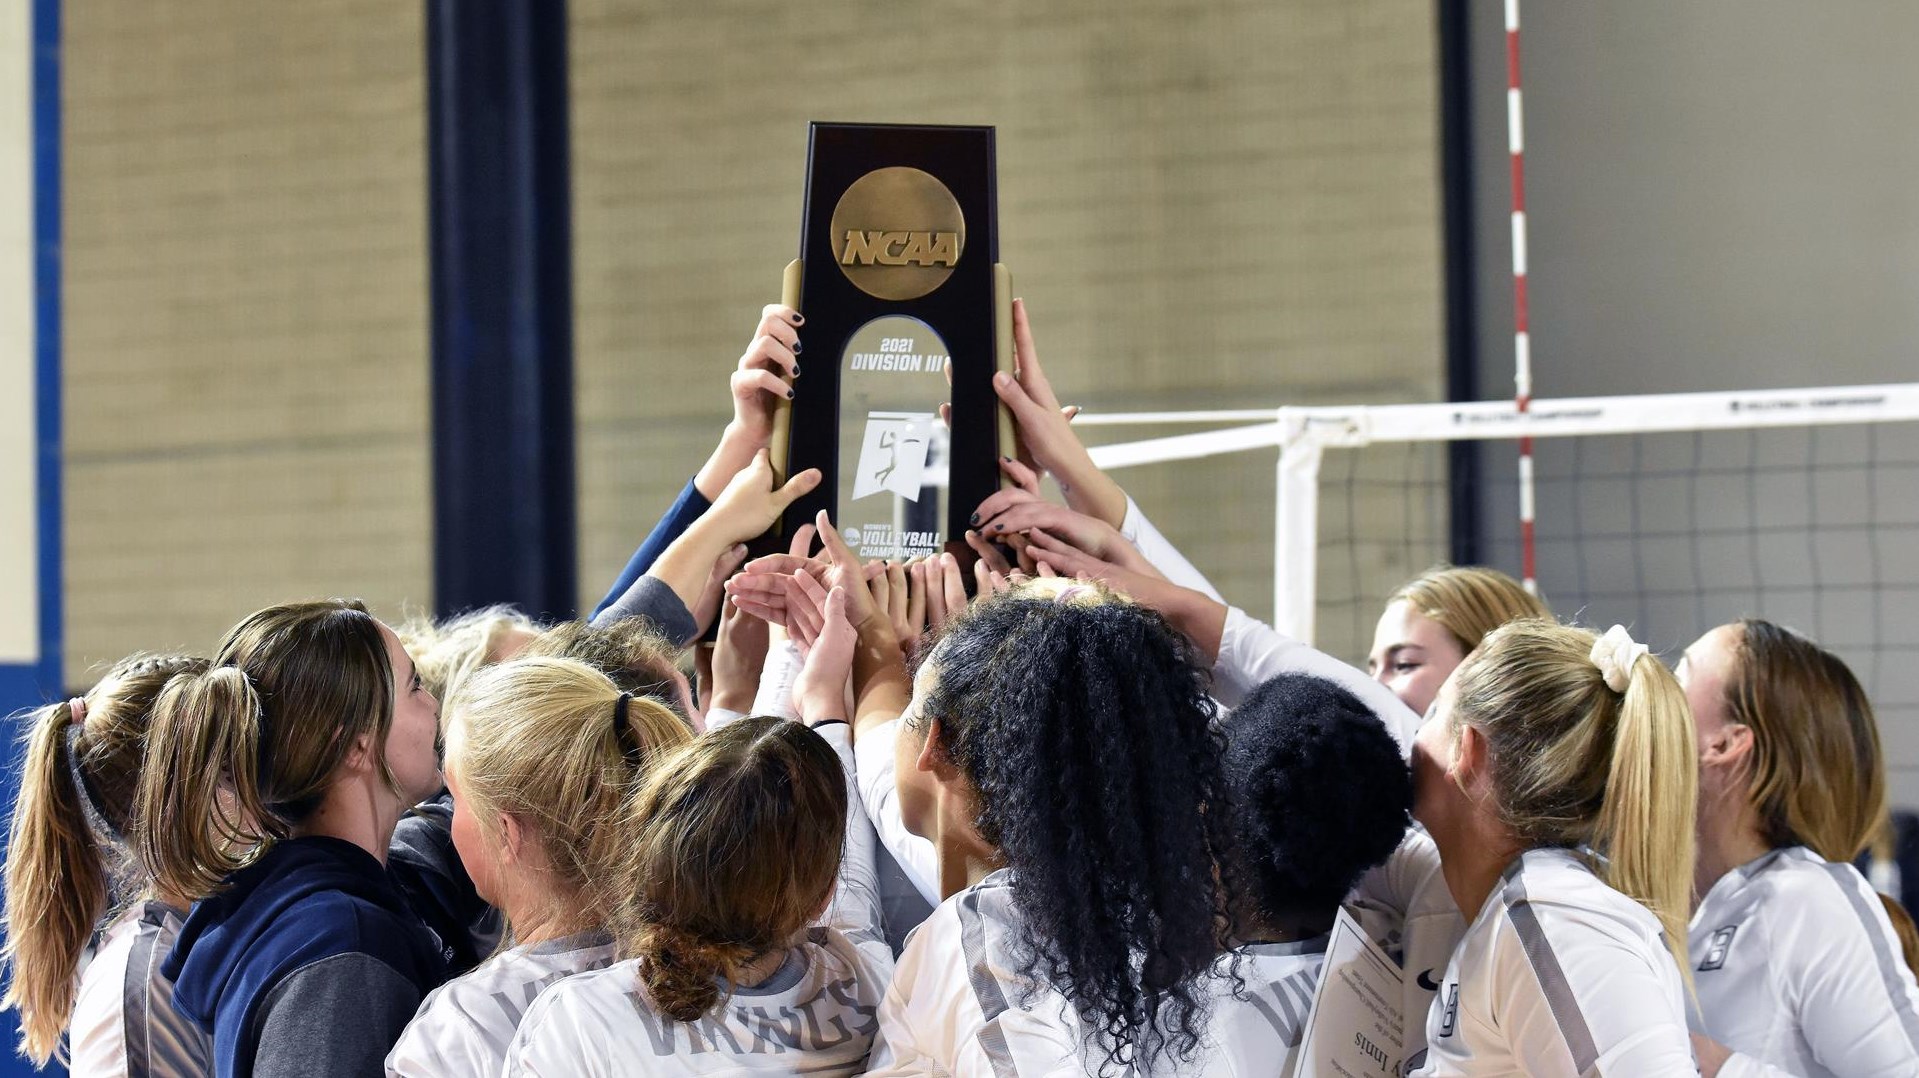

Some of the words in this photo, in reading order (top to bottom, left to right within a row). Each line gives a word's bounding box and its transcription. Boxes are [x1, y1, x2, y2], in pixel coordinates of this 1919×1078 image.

[842, 230, 959, 267] NCAA
[880, 338, 914, 353] 2021
[851, 353, 922, 371] DIVISION
[925, 355, 943, 372] III
[862, 531, 941, 547] VOLLEYBALL
[859, 546, 934, 558] CHAMPIONSHIP
[1354, 1032, 1389, 1072] Innis
